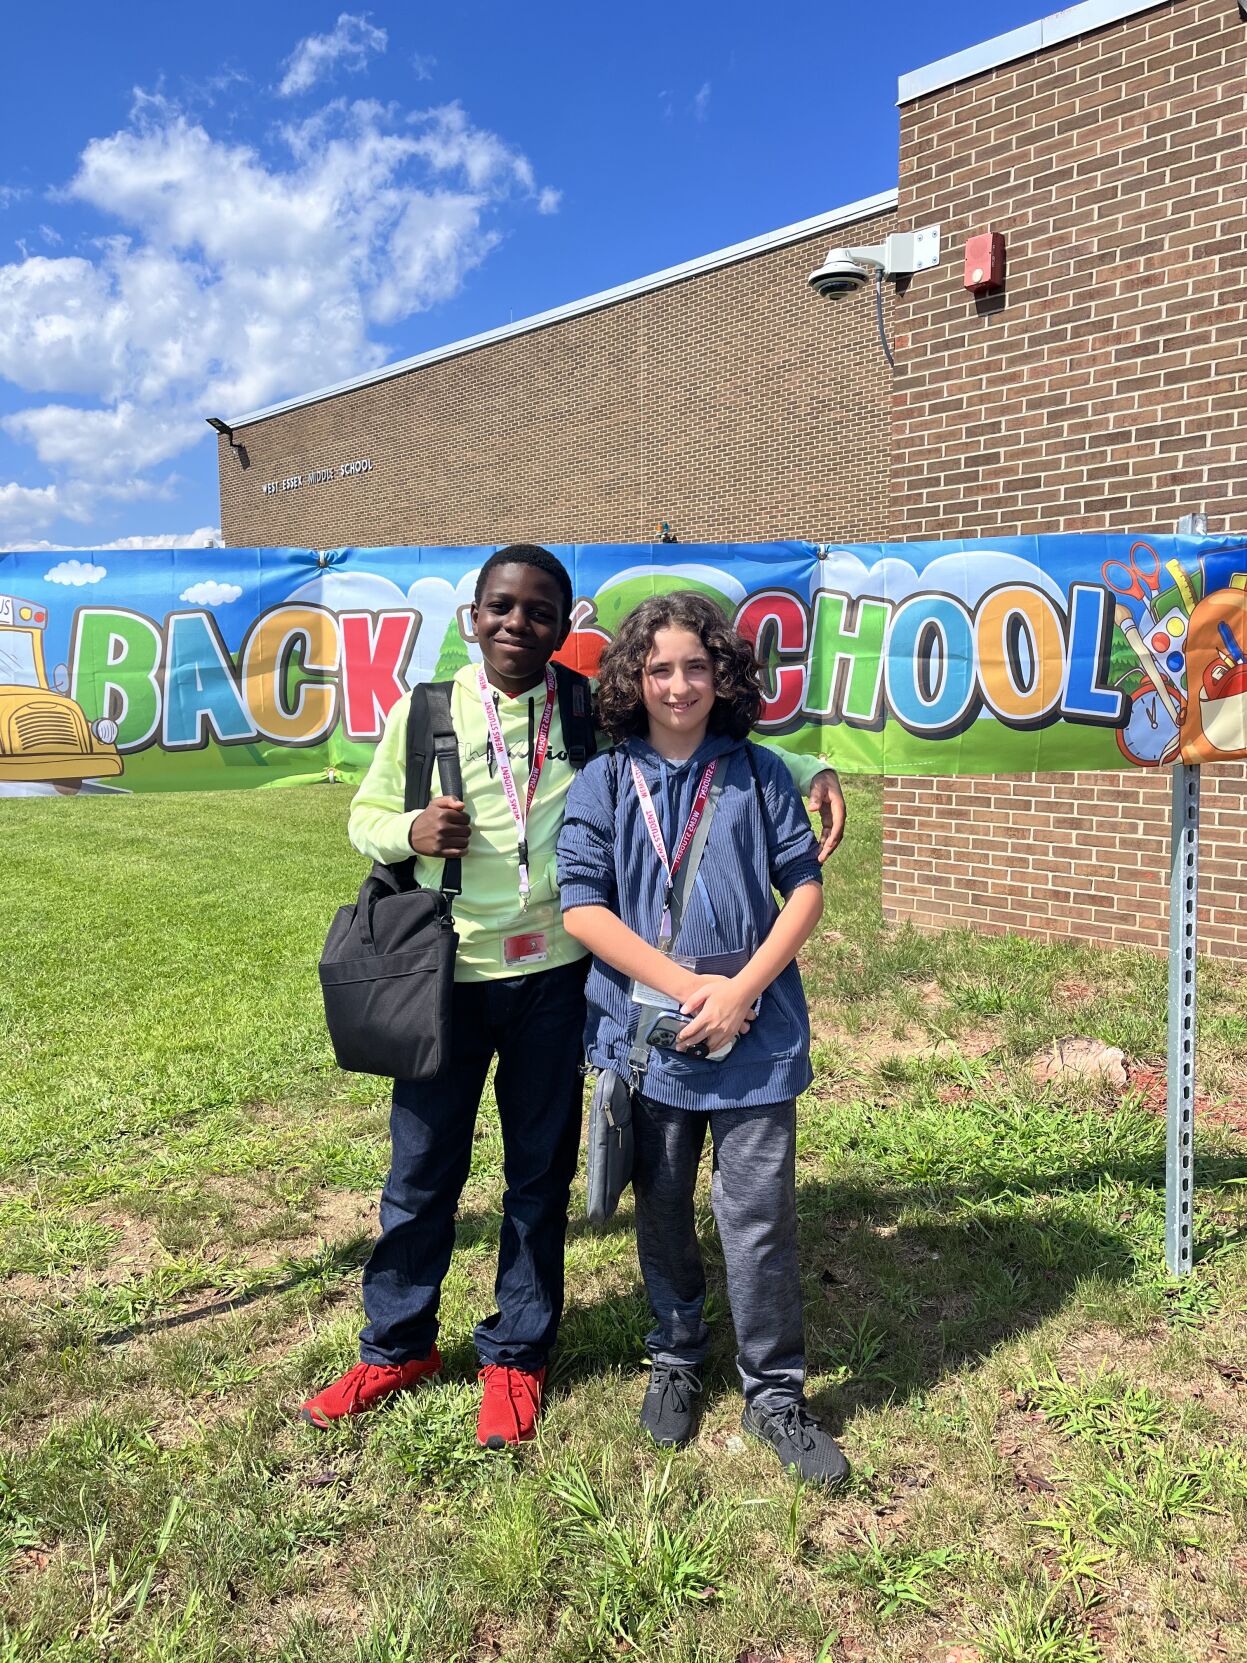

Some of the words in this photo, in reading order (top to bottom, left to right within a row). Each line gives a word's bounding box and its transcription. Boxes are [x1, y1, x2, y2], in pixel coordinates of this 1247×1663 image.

[262, 482, 279, 495] WEST
[282, 475, 303, 490] ESSEX
[308, 468, 334, 485] MIDDLE
[340, 459, 373, 477] SCHOOL
[69, 601, 422, 754] BACK
[732, 580, 1133, 741] CHOOL
[485, 701, 499, 731] STUDENT
[493, 731, 504, 753] WEMS
[501, 766, 515, 798] STUDENT
[636, 778, 648, 798] WEMS
[510, 798, 521, 820] WEMS
[646, 810, 659, 842] STUDENT
